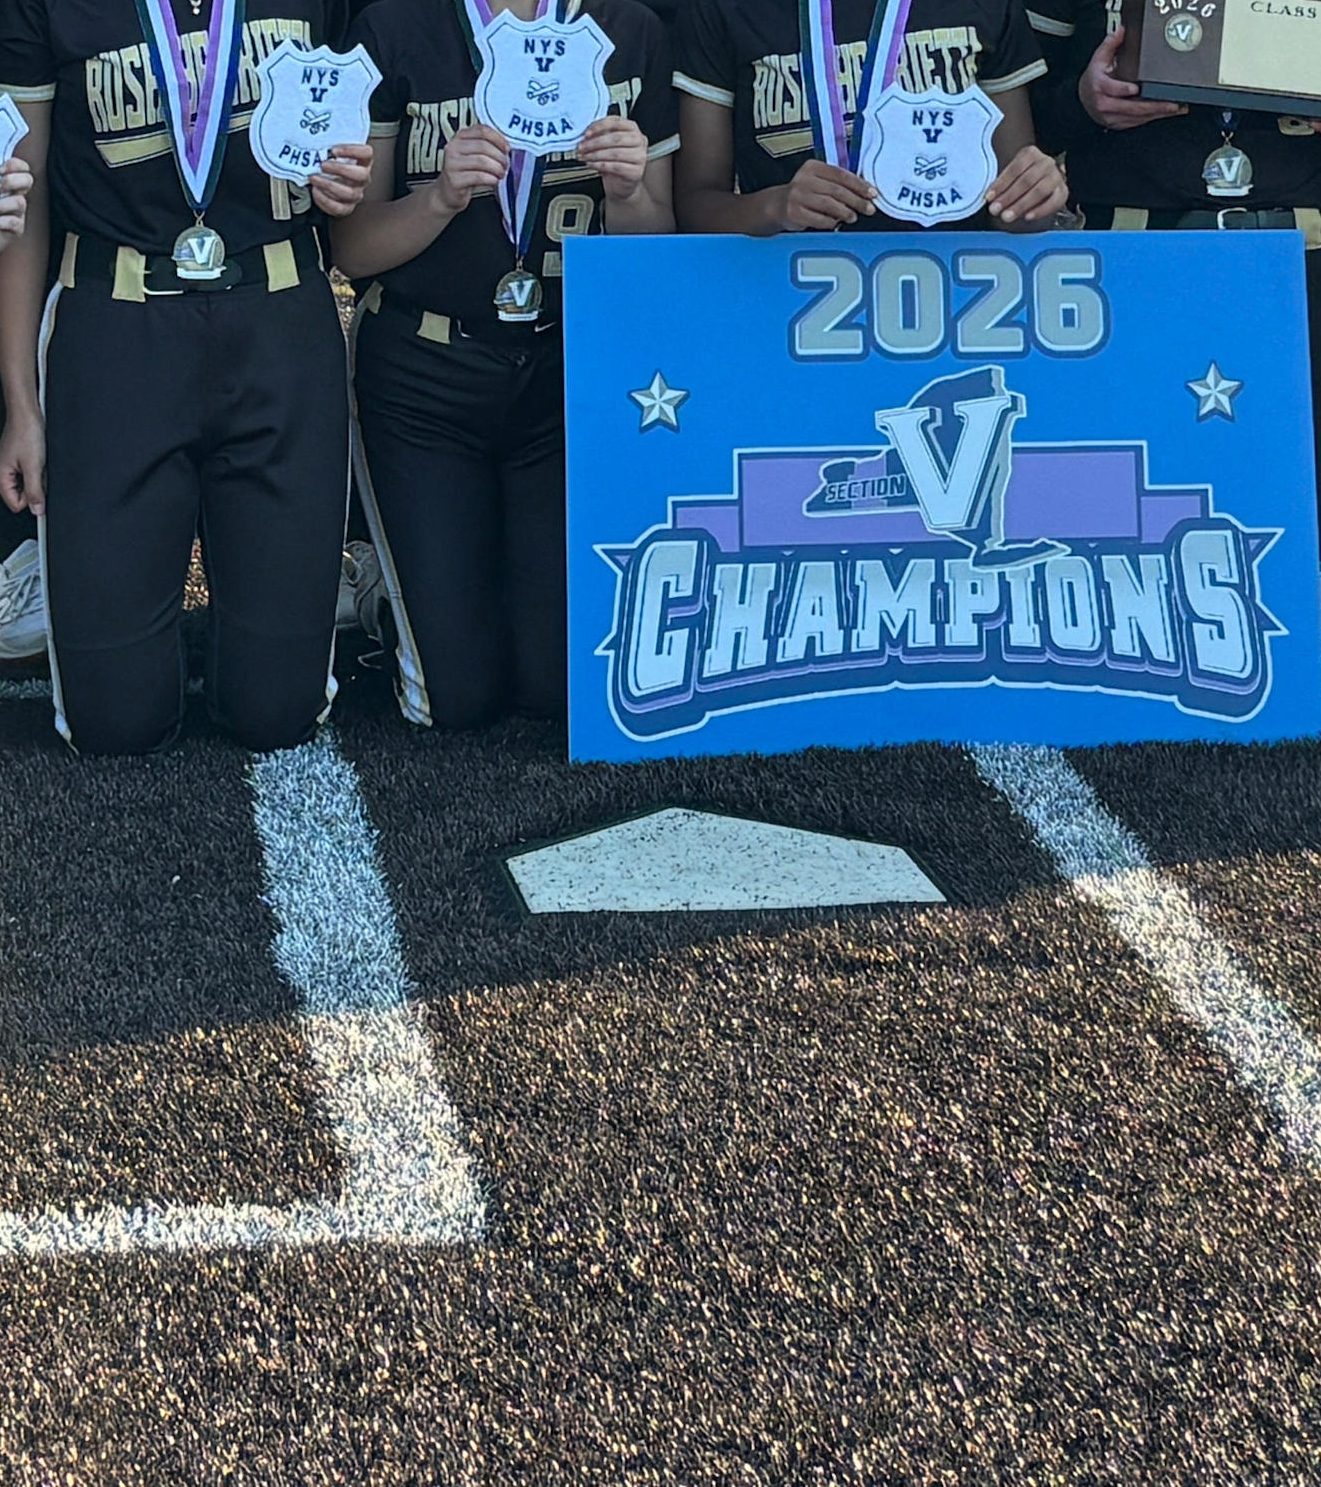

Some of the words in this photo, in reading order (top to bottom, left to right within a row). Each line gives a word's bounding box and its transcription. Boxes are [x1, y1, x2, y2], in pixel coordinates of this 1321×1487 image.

[1250, 0, 1318, 19] CLASS
[524, 38, 566, 56] NYS
[301, 69, 340, 86] NYS
[508, 114, 574, 137] PHSAA
[912, 110, 954, 127] NYS
[897, 186, 963, 208] PHSAA
[791, 252, 1106, 358] 2026
[826, 474, 908, 502] SECTION
[875, 395, 1023, 529] V
[626, 528, 1255, 697] CHAMPIONS
